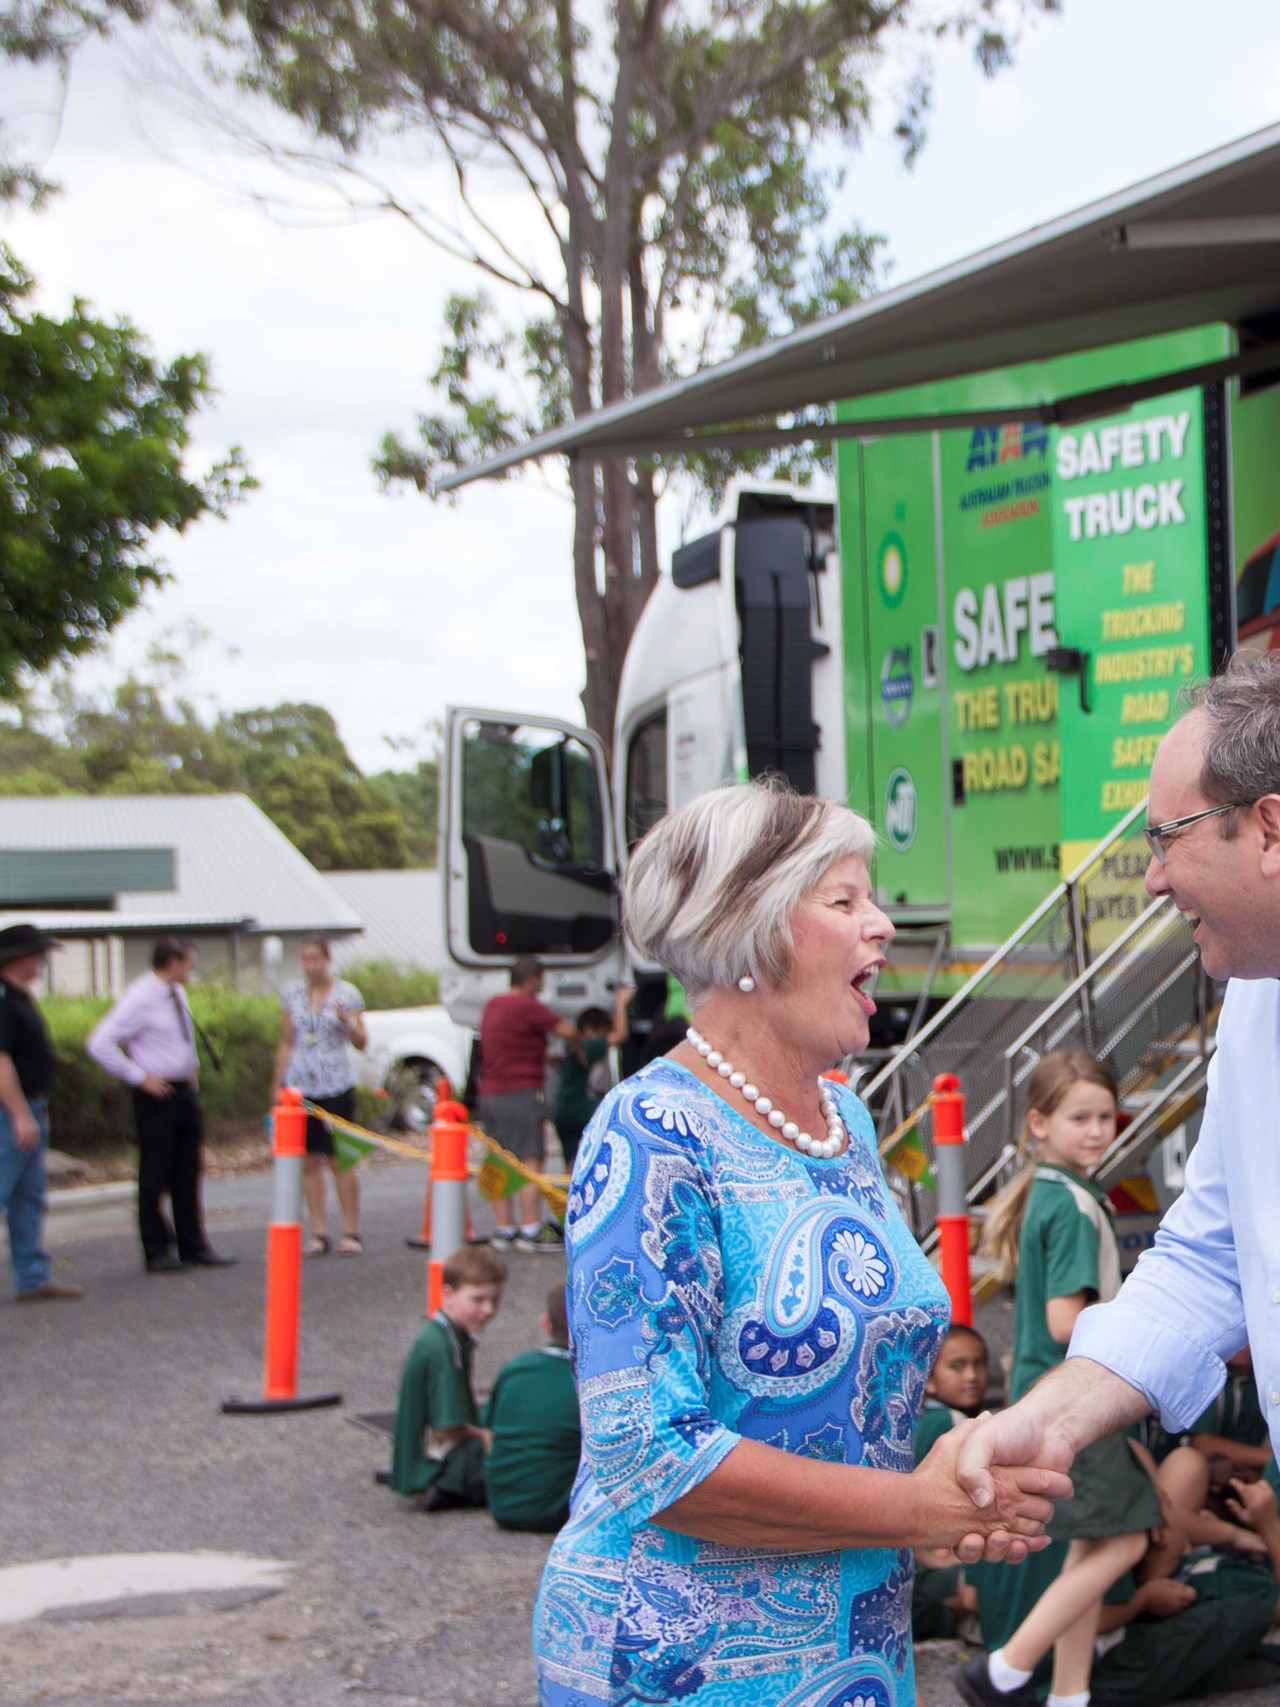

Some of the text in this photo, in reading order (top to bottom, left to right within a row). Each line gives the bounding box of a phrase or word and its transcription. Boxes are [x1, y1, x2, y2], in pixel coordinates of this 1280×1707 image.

[1056, 412, 1191, 480] SAFETY
[1064, 478, 1187, 541] TRUCK
[1123, 561, 1156, 596] THE
[1102, 601, 1185, 642] TRUCKING
[955, 685, 999, 731] THE
[1121, 690, 1169, 724] ROAD
[962, 745, 1029, 793] ROAD
